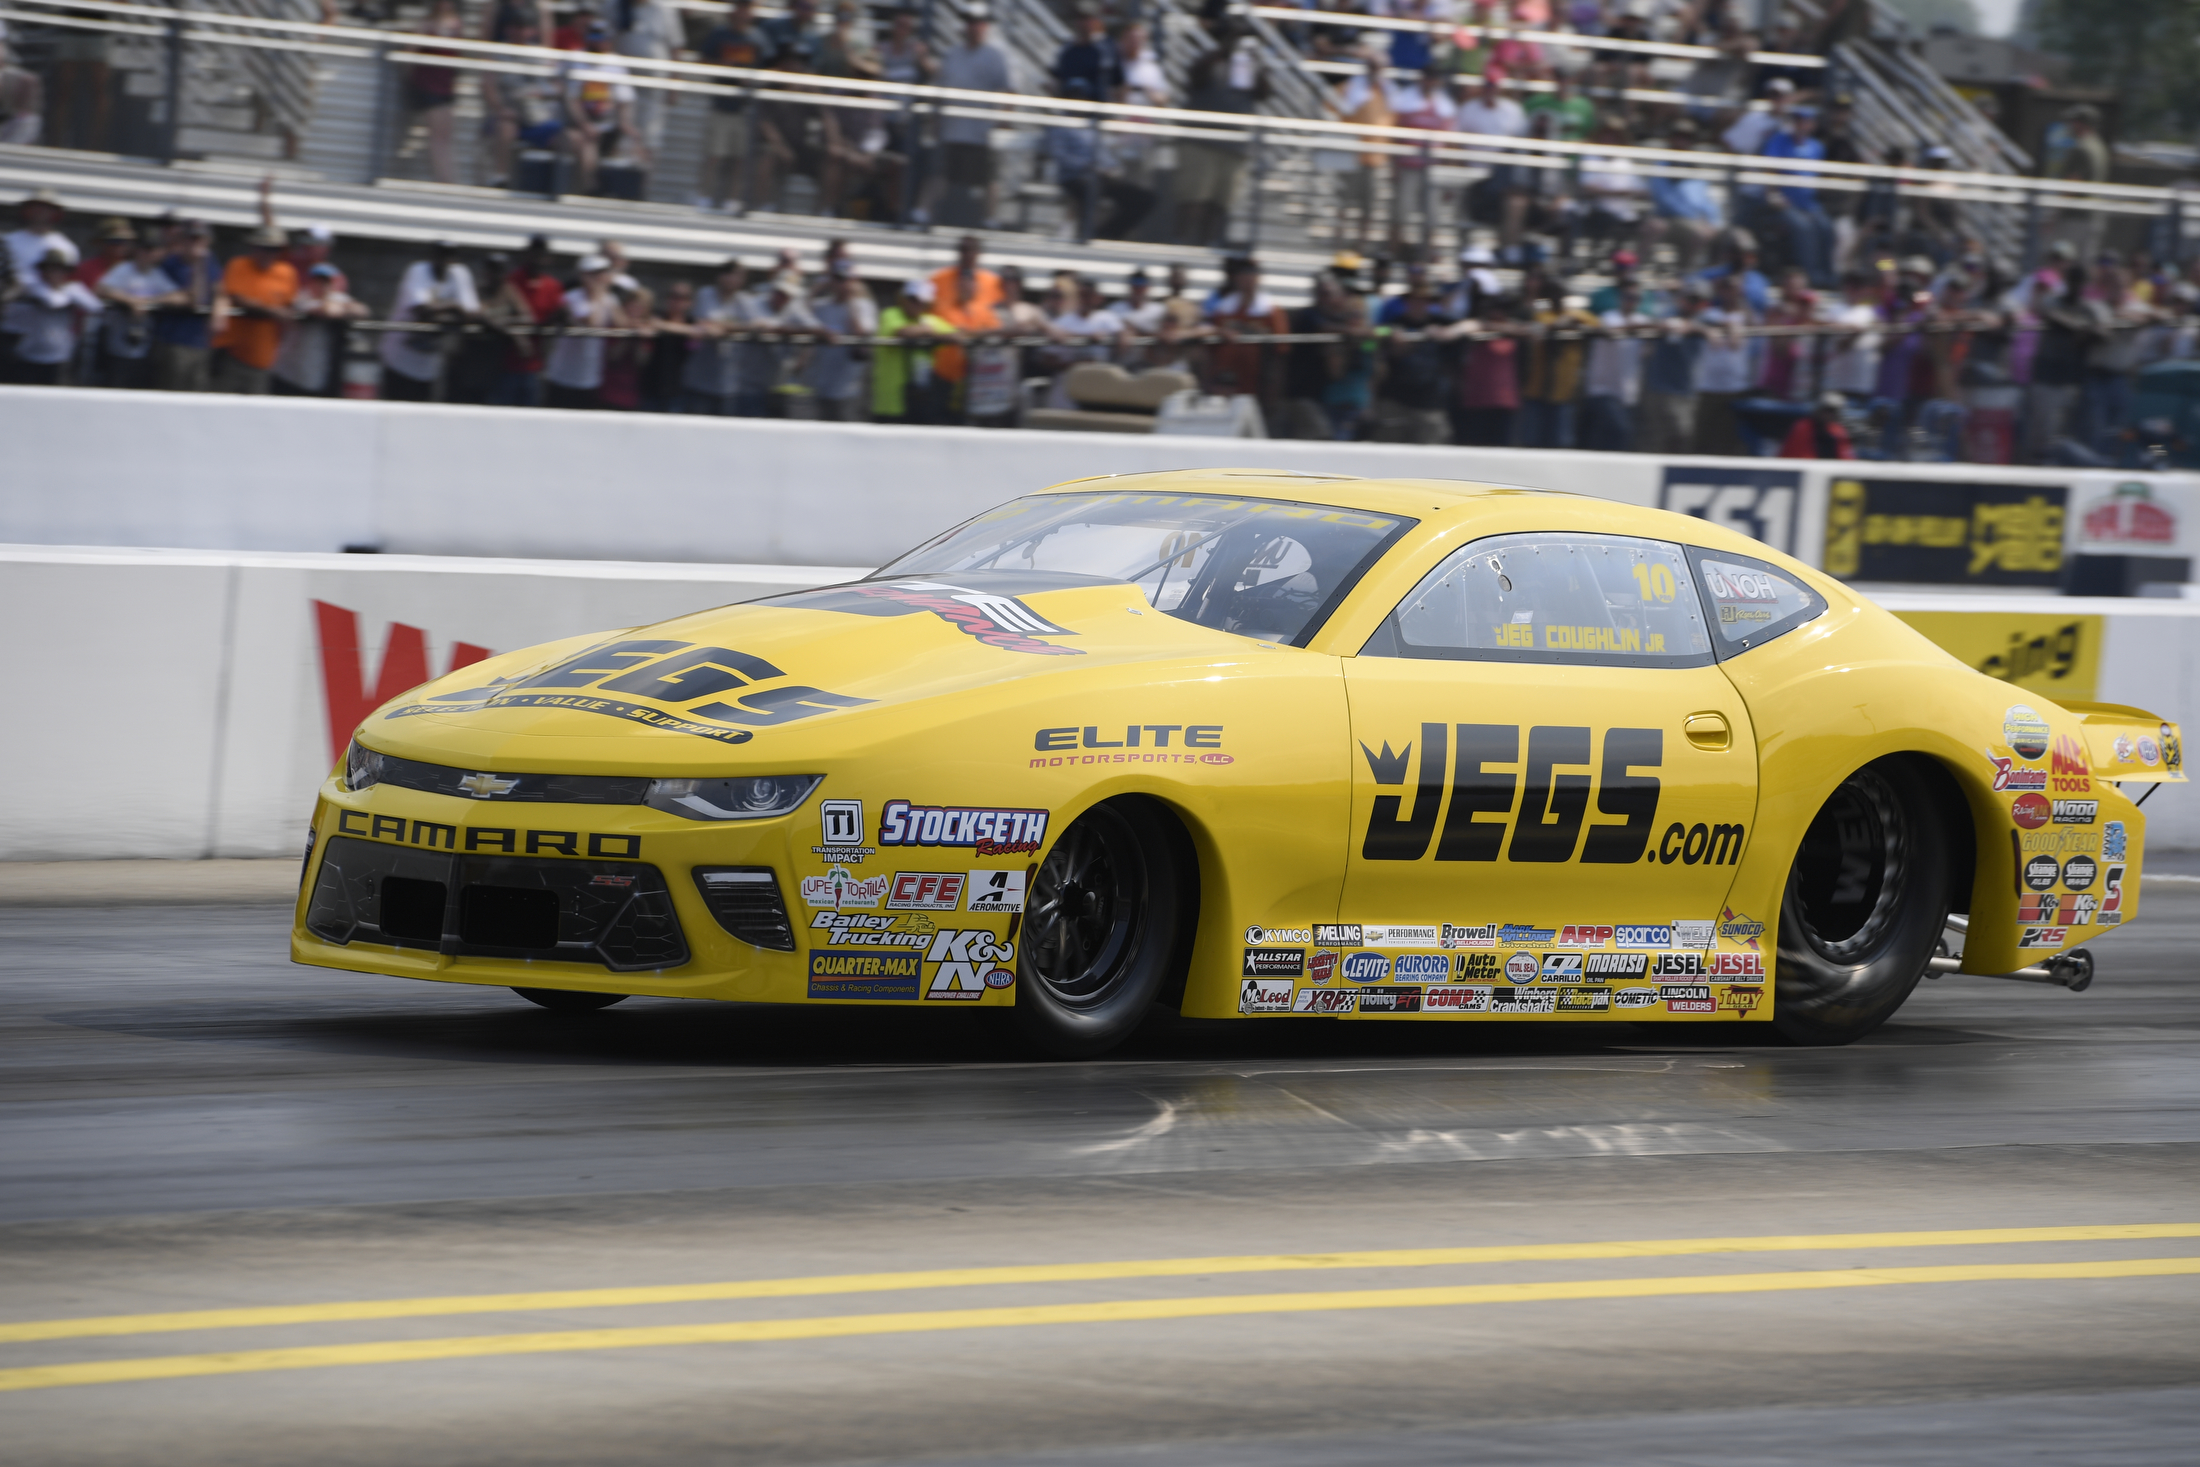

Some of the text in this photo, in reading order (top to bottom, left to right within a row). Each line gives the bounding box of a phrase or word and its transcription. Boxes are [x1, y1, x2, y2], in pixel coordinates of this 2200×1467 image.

[1632, 562, 1675, 603] 10
[1705, 570, 1777, 599] UNOH
[1496, 623, 1533, 648] JEG
[1545, 625, 1641, 652] COUGHLIN
[1645, 633, 1666, 652] JR
[533, 696, 611, 711] VALUE
[626, 707, 745, 741] SUPPORT
[1034, 725, 1224, 752] ELITE
[1204, 755, 1230, 764] LLC
[2052, 777, 2090, 792] TOOLS
[2052, 800, 2099, 816] Wood
[882, 802, 1048, 846] STOCKSETH
[338, 809, 641, 859] CAMARO
[812, 846, 875, 855] TRANSPORTATION
[975, 838, 1039, 857] Racing
[823, 854, 865, 863] IMPACT
[803, 879, 833, 896] LUPE
[893, 875, 962, 901] CFE
[968, 902, 1021, 912] AEROMOTIVE
[810, 911, 898, 930] Bailey
[828, 926, 934, 950] Trucking
[1264, 929, 1311, 943] KYMCO
[1319, 925, 1361, 941] MELLING
[1388, 928, 1435, 938] PERFORMANCE
[1441, 924, 1496, 939] Browell
[1559, 925, 1613, 944] ARP
[1616, 926, 1670, 947] sparco
[1721, 924, 1762, 935] SUNOCO
[812, 956, 919, 976] QUARTER-MAX
[1256, 953, 1302, 962] ALLSTAR
[1341, 952, 1390, 979] CLEVITE
[1394, 954, 1449, 973] AURORA
[1467, 953, 1496, 966] Auto
[1586, 954, 1647, 973] MOROSO
[1652, 954, 1707, 975] JESEL
[1709, 954, 1765, 975] JESEL
[1464, 966, 1501, 979] Meter
[1508, 962, 1536, 973] TOTAL SEAL
[986, 971, 1013, 986] NHRA
[1395, 973, 1447, 982] BEARING COMPANY
[1541, 974, 1582, 983] CARRILLO
[811, 983, 915, 994] Chassis & Racing Components
[1243, 988, 1291, 1003] McLeod
[1614, 989, 1659, 1005] COMETIC
[1662, 986, 1707, 999] LINCOLN
[1304, 990, 1348, 1011] XRP
[1361, 988, 1397, 1010] Holley
[1427, 989, 1474, 1006] COMP
[1489, 999, 1555, 1013] Crankshafts
[1571, 988, 1610, 1009] Racepak
[1672, 1001, 1712, 1011] WELDERS
[1719, 989, 1763, 1009] INDY
